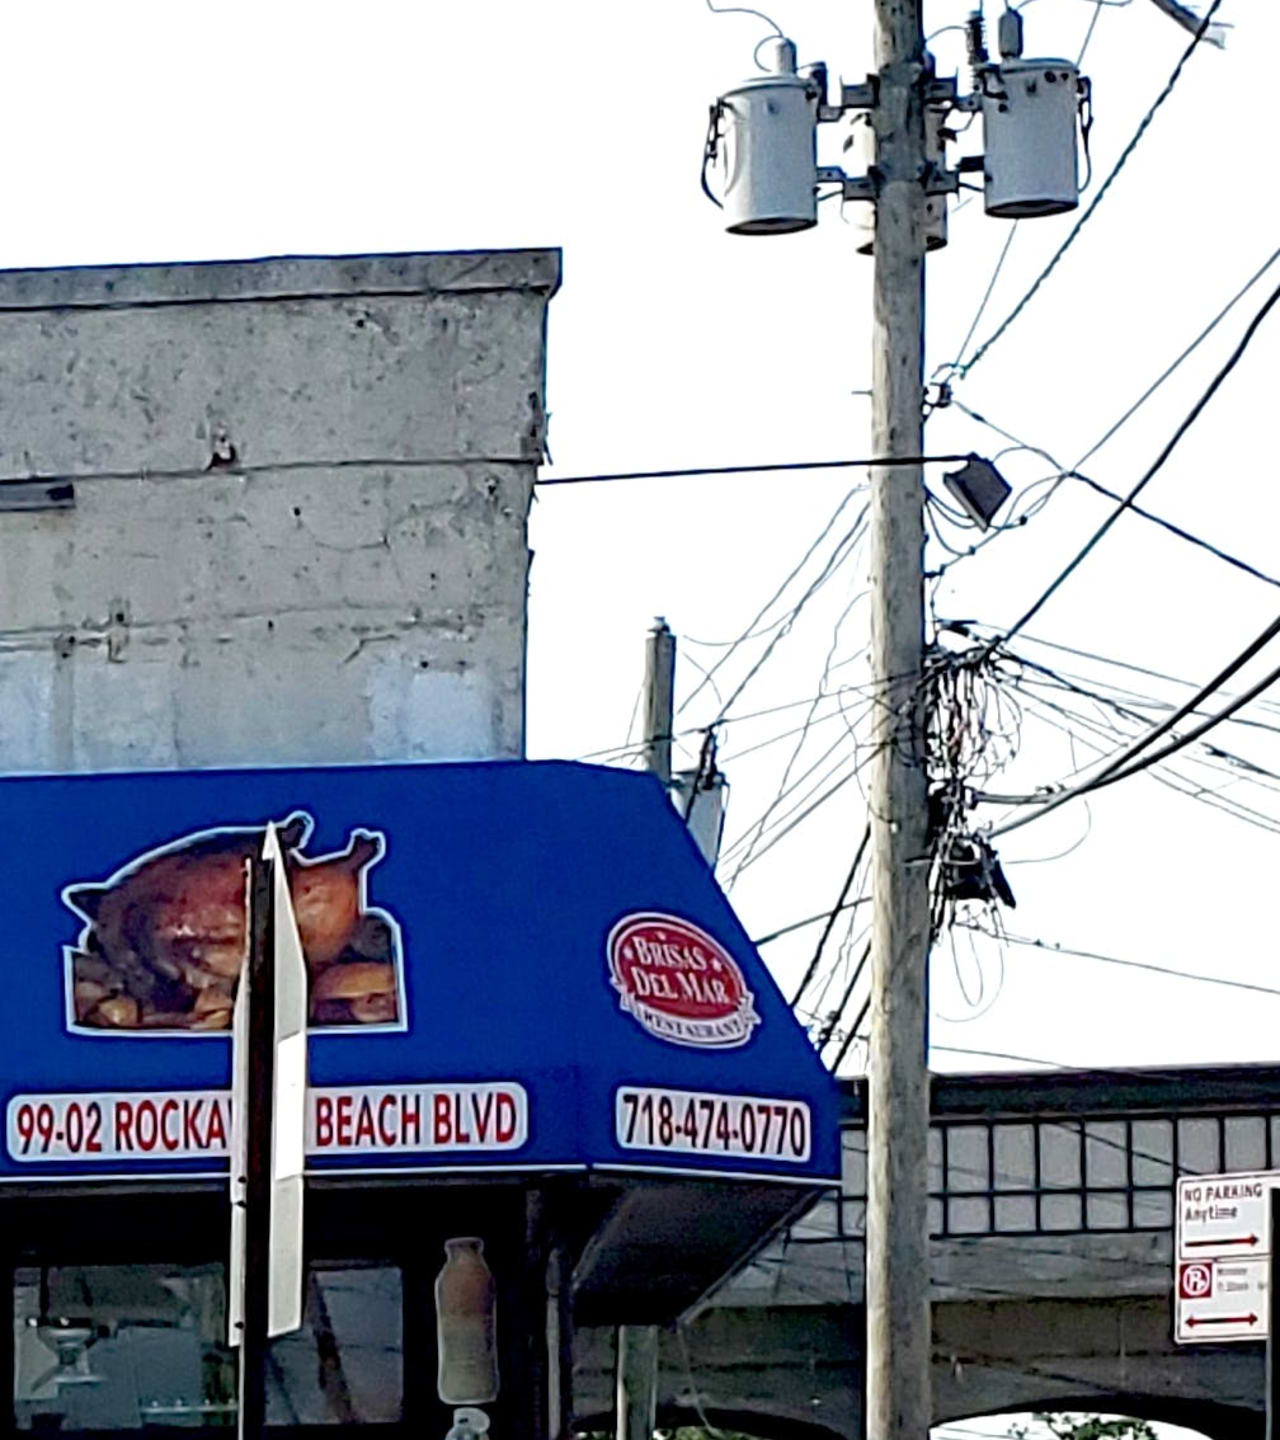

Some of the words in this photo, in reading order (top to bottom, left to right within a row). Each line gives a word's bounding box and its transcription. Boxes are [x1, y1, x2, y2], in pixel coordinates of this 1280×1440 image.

[632, 935, 708, 971] BRISAS
[631, 966, 679, 999] DEL
[676, 971, 730, 1004] MAR
[114, 1098, 232, 1152] ROCKA
[315, 1094, 421, 1147] BEACH
[433, 1092, 517, 1145] BLVD
[1184, 1187, 1202, 1201] NO
[1205, 1183, 1263, 1201] PARKING
[1184, 1205, 1238, 1223] Anytime
